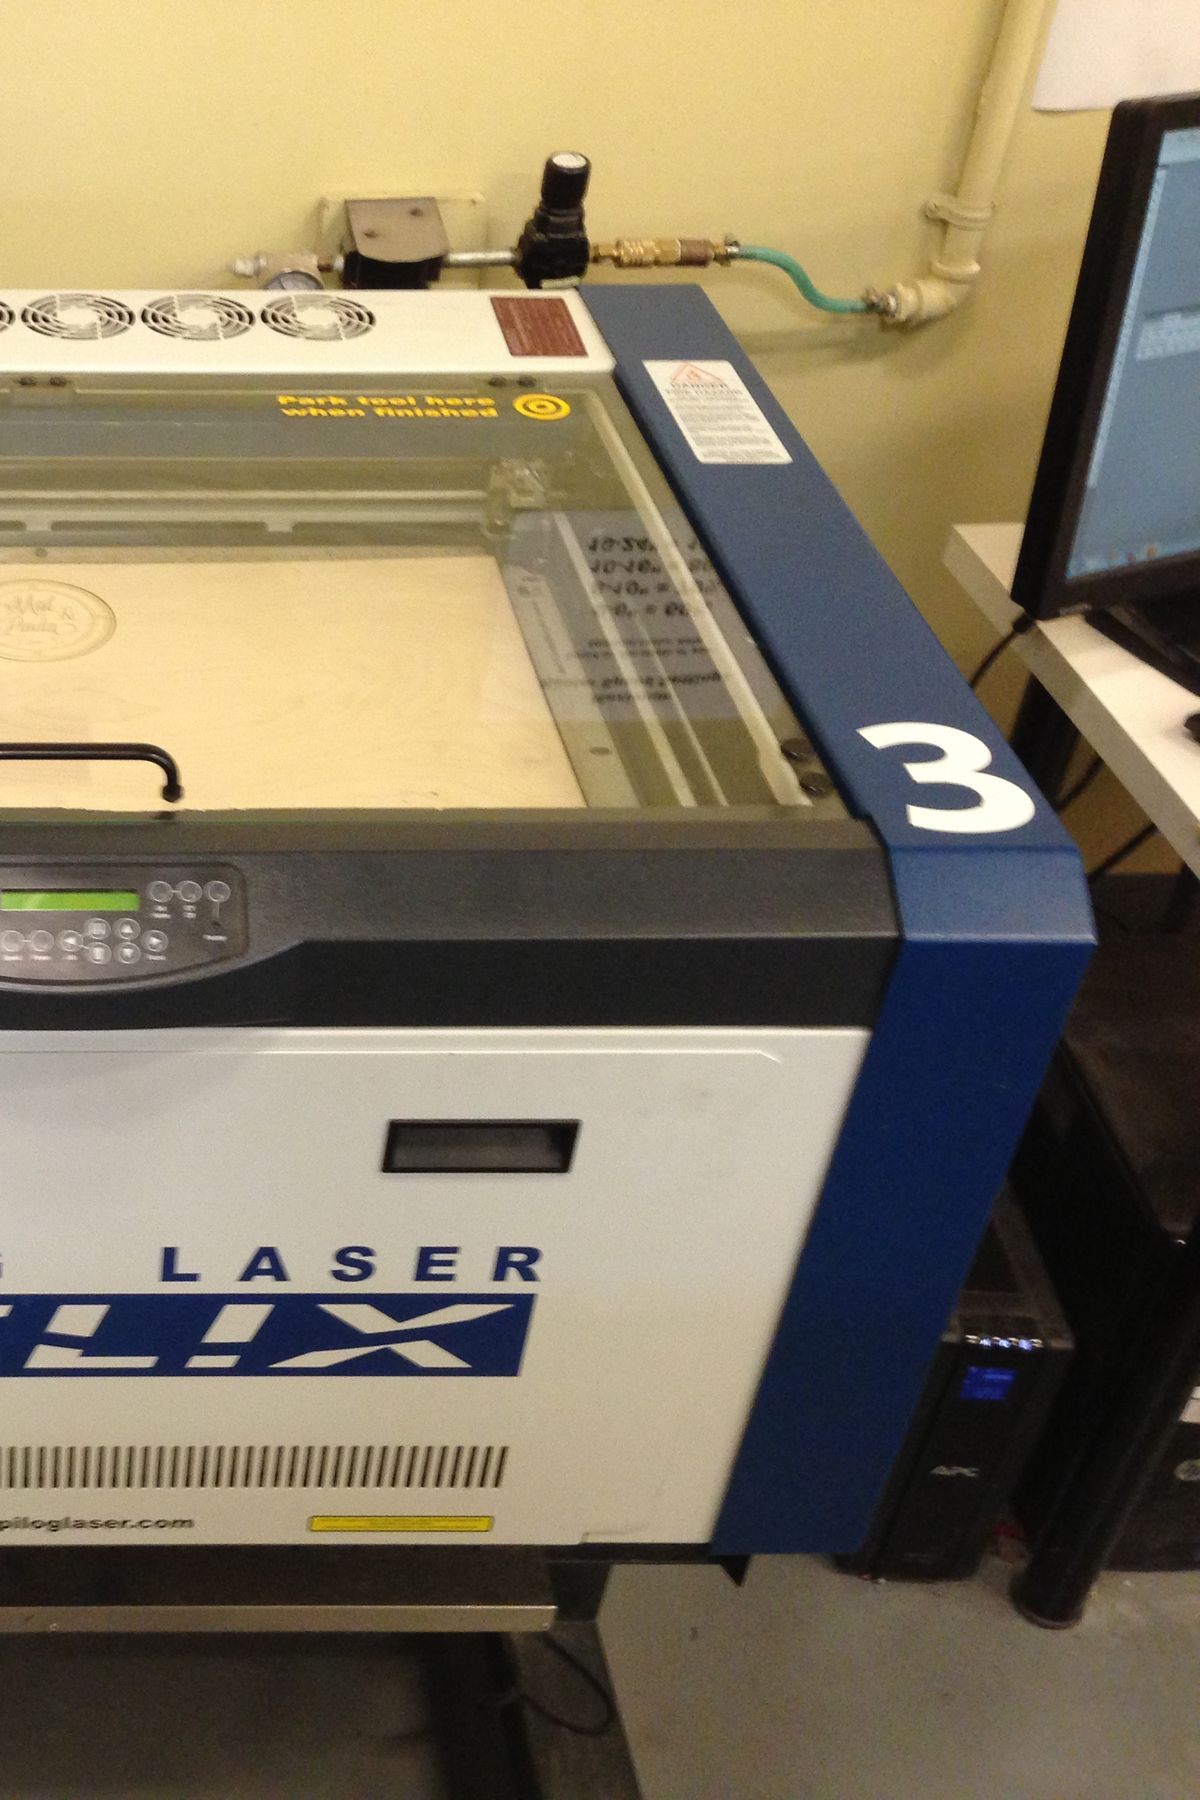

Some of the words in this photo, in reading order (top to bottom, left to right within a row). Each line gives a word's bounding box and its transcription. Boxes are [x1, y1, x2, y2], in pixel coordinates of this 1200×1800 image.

[277, 395, 348, 406] Park
[356, 395, 417, 406] tool
[425, 395, 496, 407] here
[281, 408, 366, 417] when
[373, 407, 499, 418] finished
[856, 721, 1036, 834] 3
[158, 1246, 543, 1282] LASER
